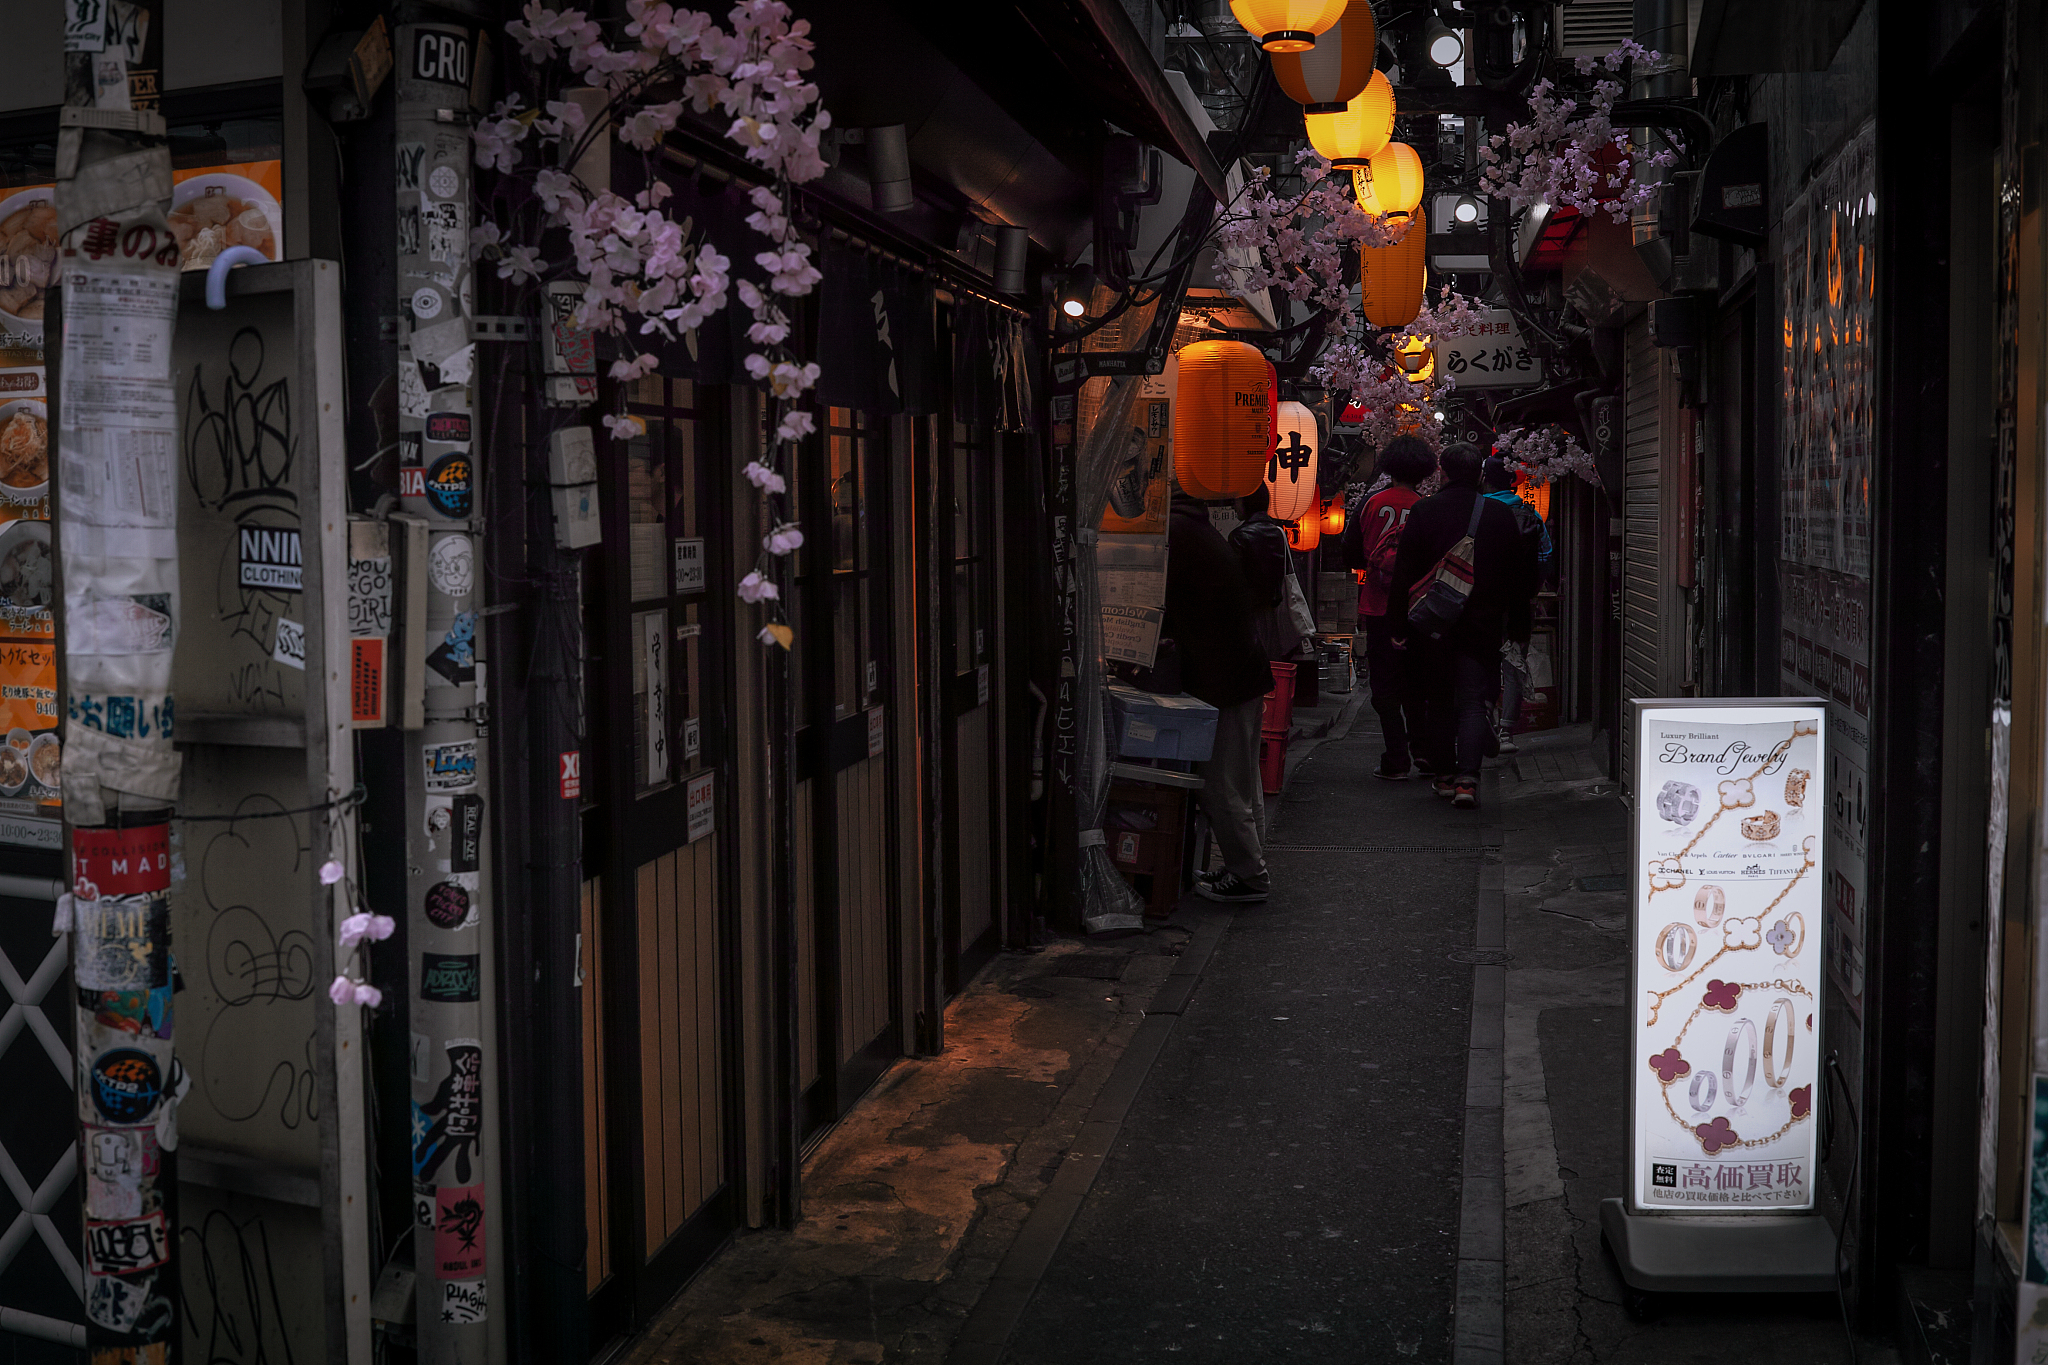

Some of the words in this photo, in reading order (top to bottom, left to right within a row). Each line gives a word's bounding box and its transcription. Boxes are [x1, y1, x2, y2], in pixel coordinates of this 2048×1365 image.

[1447, 346, 1534, 374] らくがき
[243, 567, 302, 586] CLOTHIN
[1660, 732, 1686, 740] Luxury
[1659, 741, 1735, 763] Brand
[1717, 741, 1791, 775] Jewelry
[1713, 851, 1738, 859] Cartier
[1655, 1166, 1673, 1176] 査定
[1681, 1162, 1803, 1190] 高価買取
[1655, 1176, 1673, 1185] 無料
[1653, 1188, 1802, 1203] 他店の買取価格と比べて下さい
